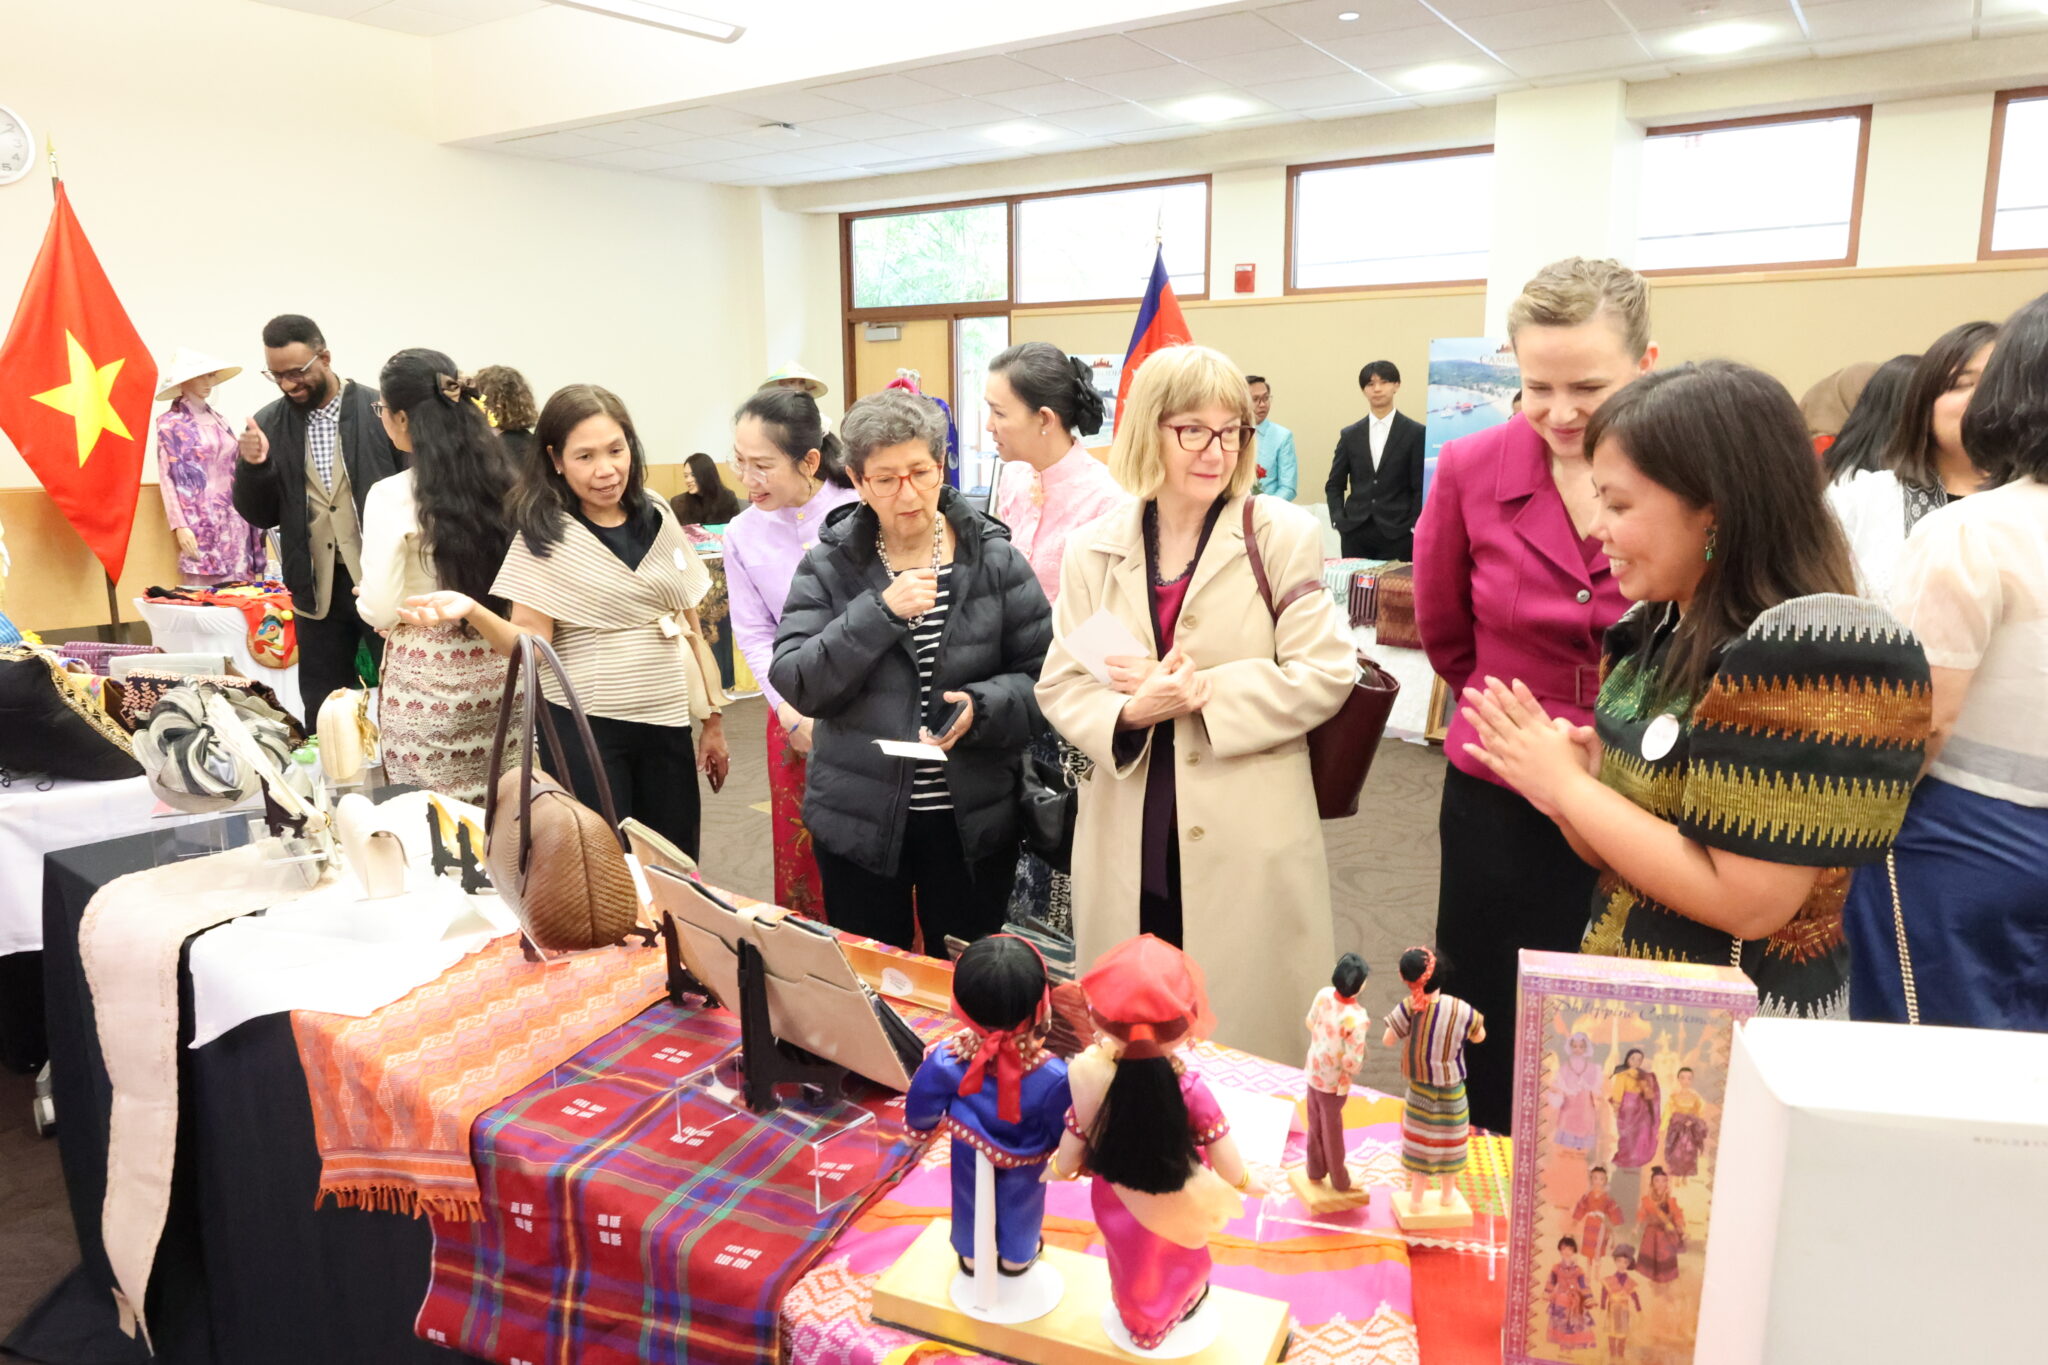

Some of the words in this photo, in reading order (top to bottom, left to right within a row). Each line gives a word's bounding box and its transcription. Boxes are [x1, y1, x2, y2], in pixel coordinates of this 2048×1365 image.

[11, 152, 20, 160] 4
[1, 162, 12, 171] 5
[1552, 998, 1632, 1019] Philippine
